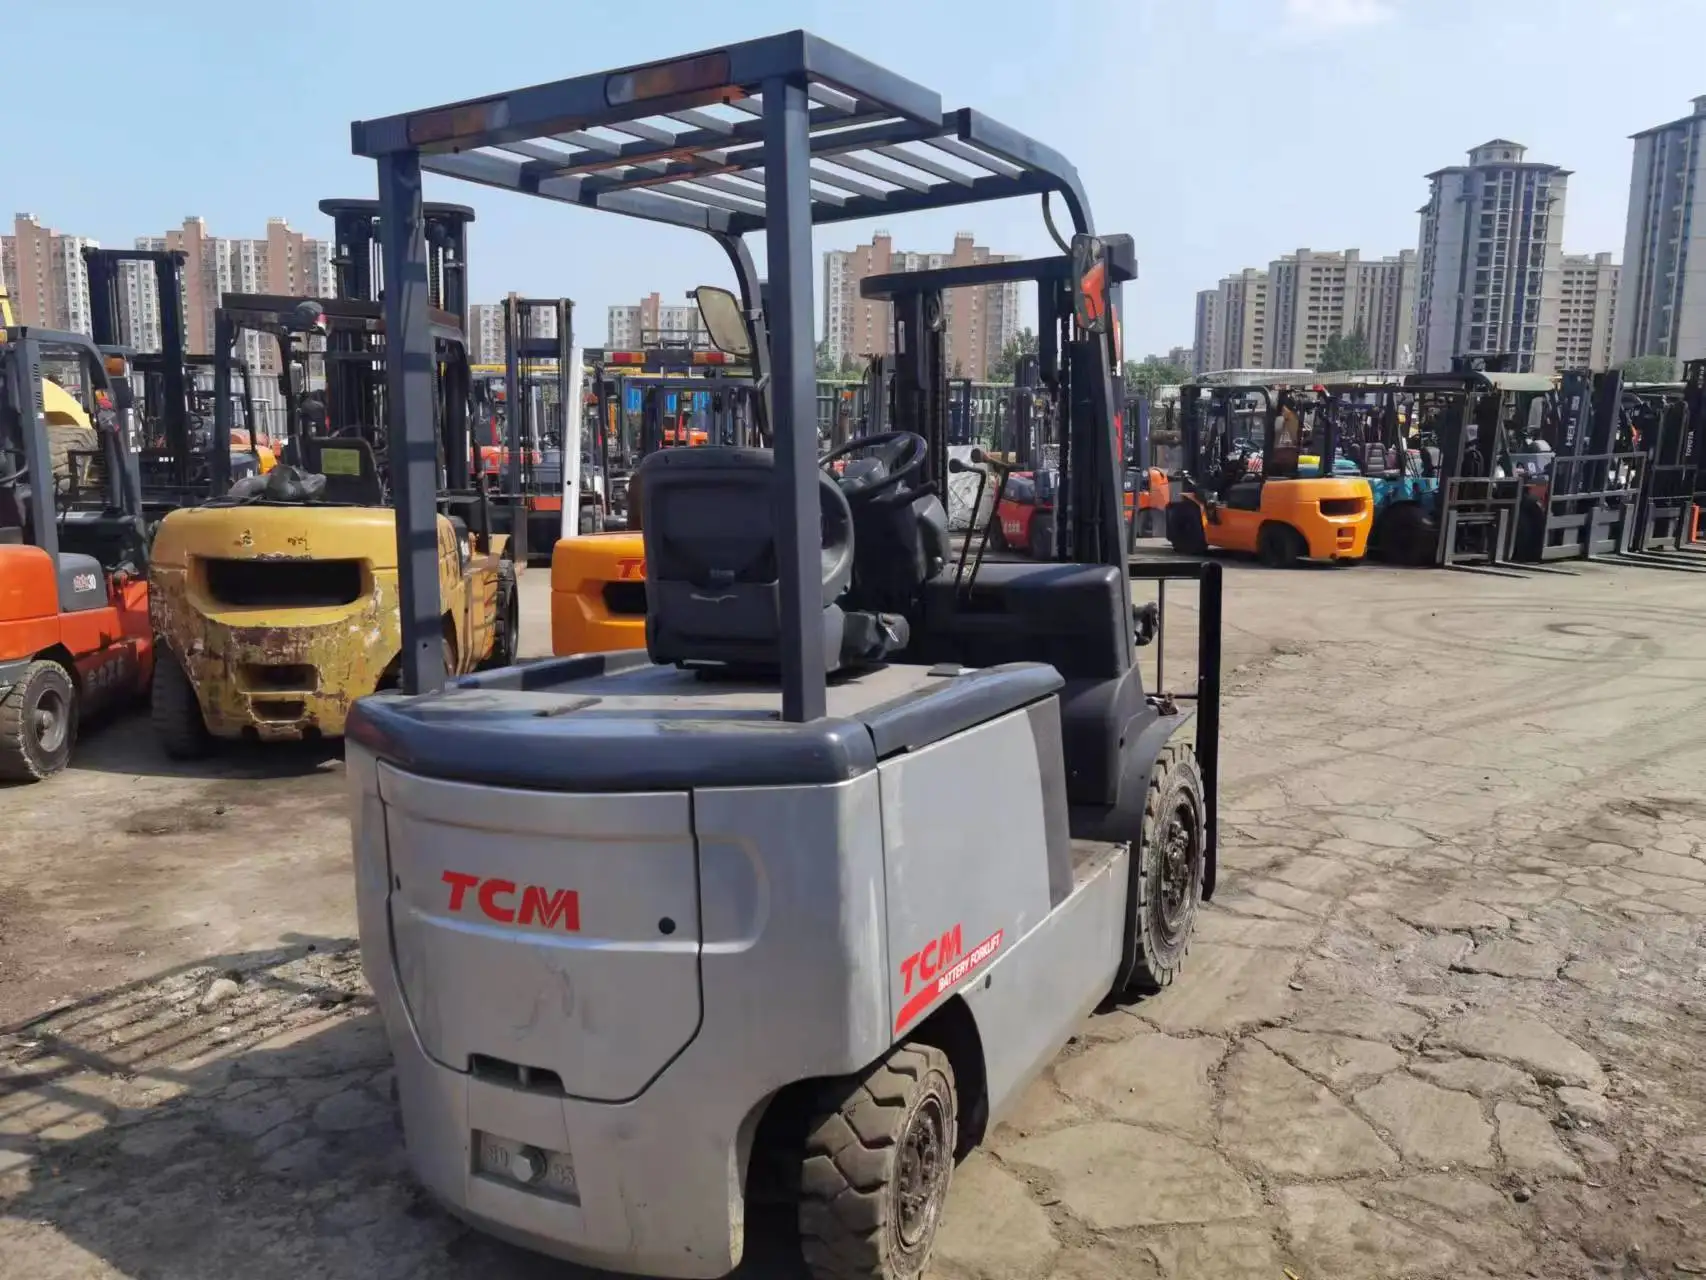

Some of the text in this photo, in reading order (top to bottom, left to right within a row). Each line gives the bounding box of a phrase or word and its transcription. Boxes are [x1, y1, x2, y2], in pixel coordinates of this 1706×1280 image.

[1685, 431, 1695, 457] TOYOTA
[441, 869, 581, 932] TCM
[900, 923, 962, 995] TCM
[938, 932, 1001, 993] BATTERY FORKLIFT
